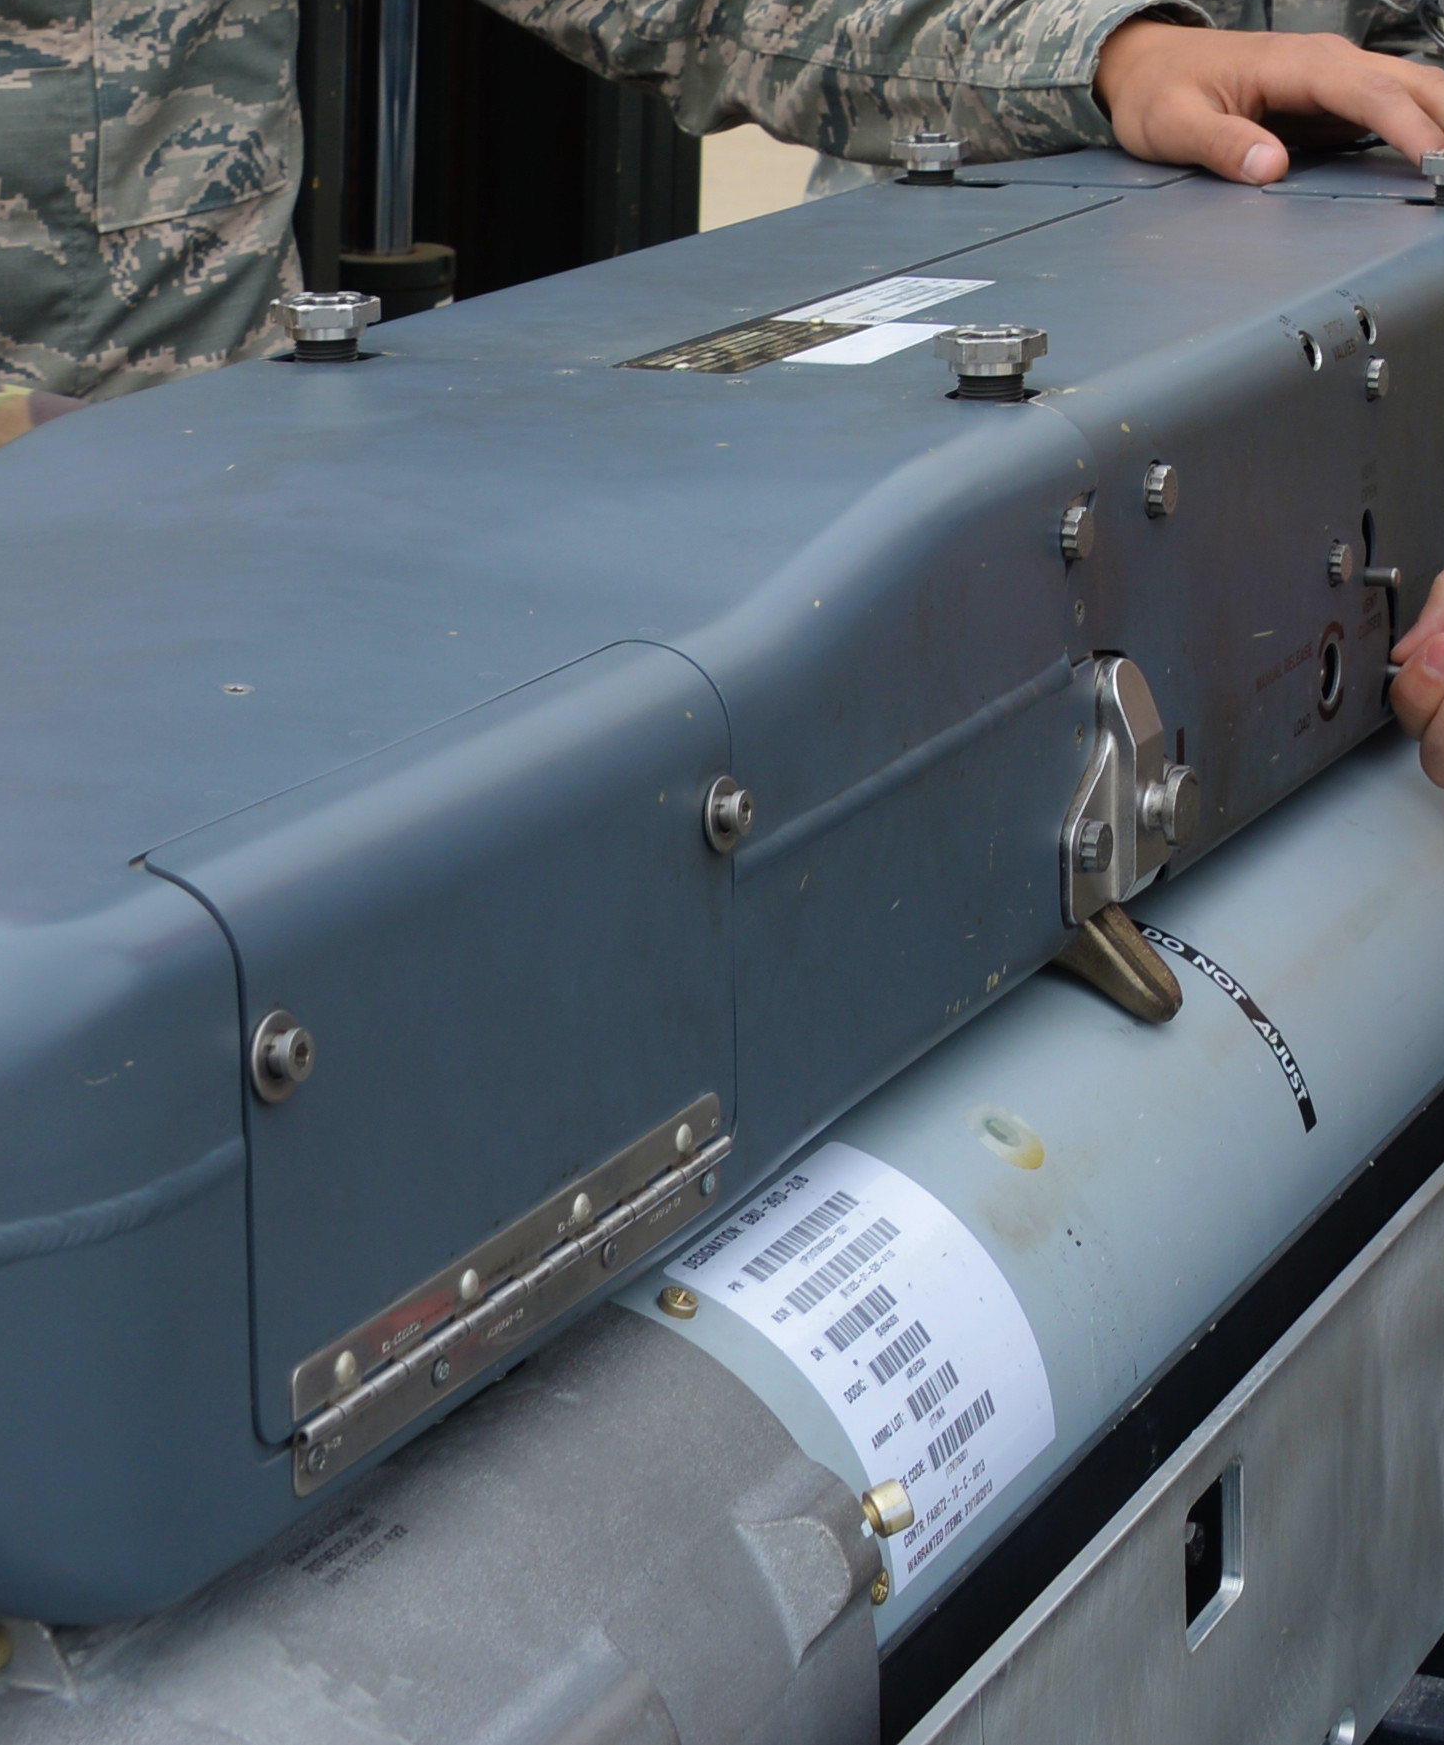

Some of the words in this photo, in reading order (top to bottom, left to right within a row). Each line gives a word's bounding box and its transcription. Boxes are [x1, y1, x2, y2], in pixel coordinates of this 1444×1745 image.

[1284, 641, 1314, 674] RELEASE
[1293, 712, 1312, 738] LOAD
[1141, 926, 1185, 953] DO
[1192, 955, 1248, 1002] NOT
[682, 1225, 745, 1270] DESIGNATION:
[871, 1424, 893, 1451] AMMO
[907, 1527, 944, 1573] WARRANTED
